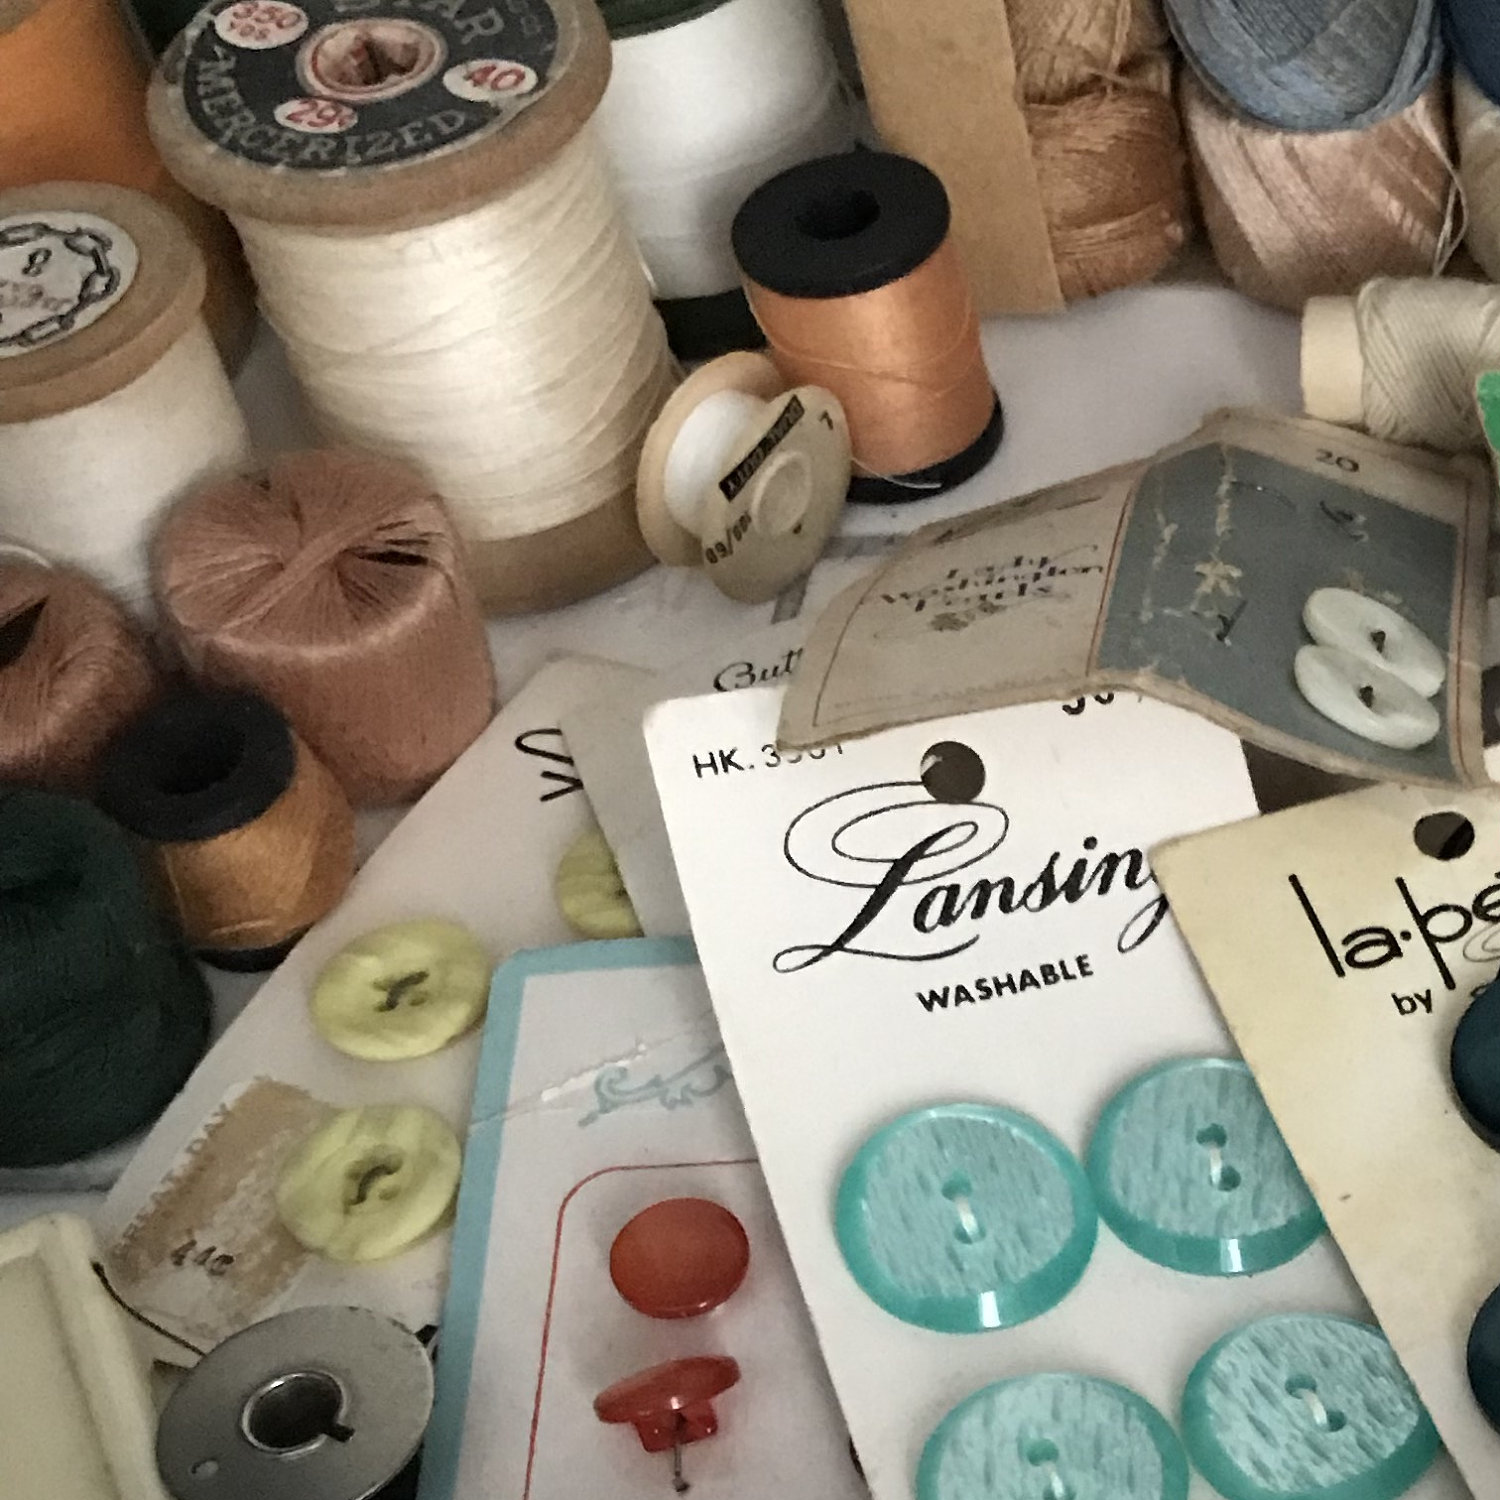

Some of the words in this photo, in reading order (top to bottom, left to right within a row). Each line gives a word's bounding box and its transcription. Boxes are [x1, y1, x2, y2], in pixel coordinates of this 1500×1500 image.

[1314, 446, 1361, 474] 20
[916, 953, 1094, 1011] WASHABLE
[1391, 988, 1433, 1016] by
